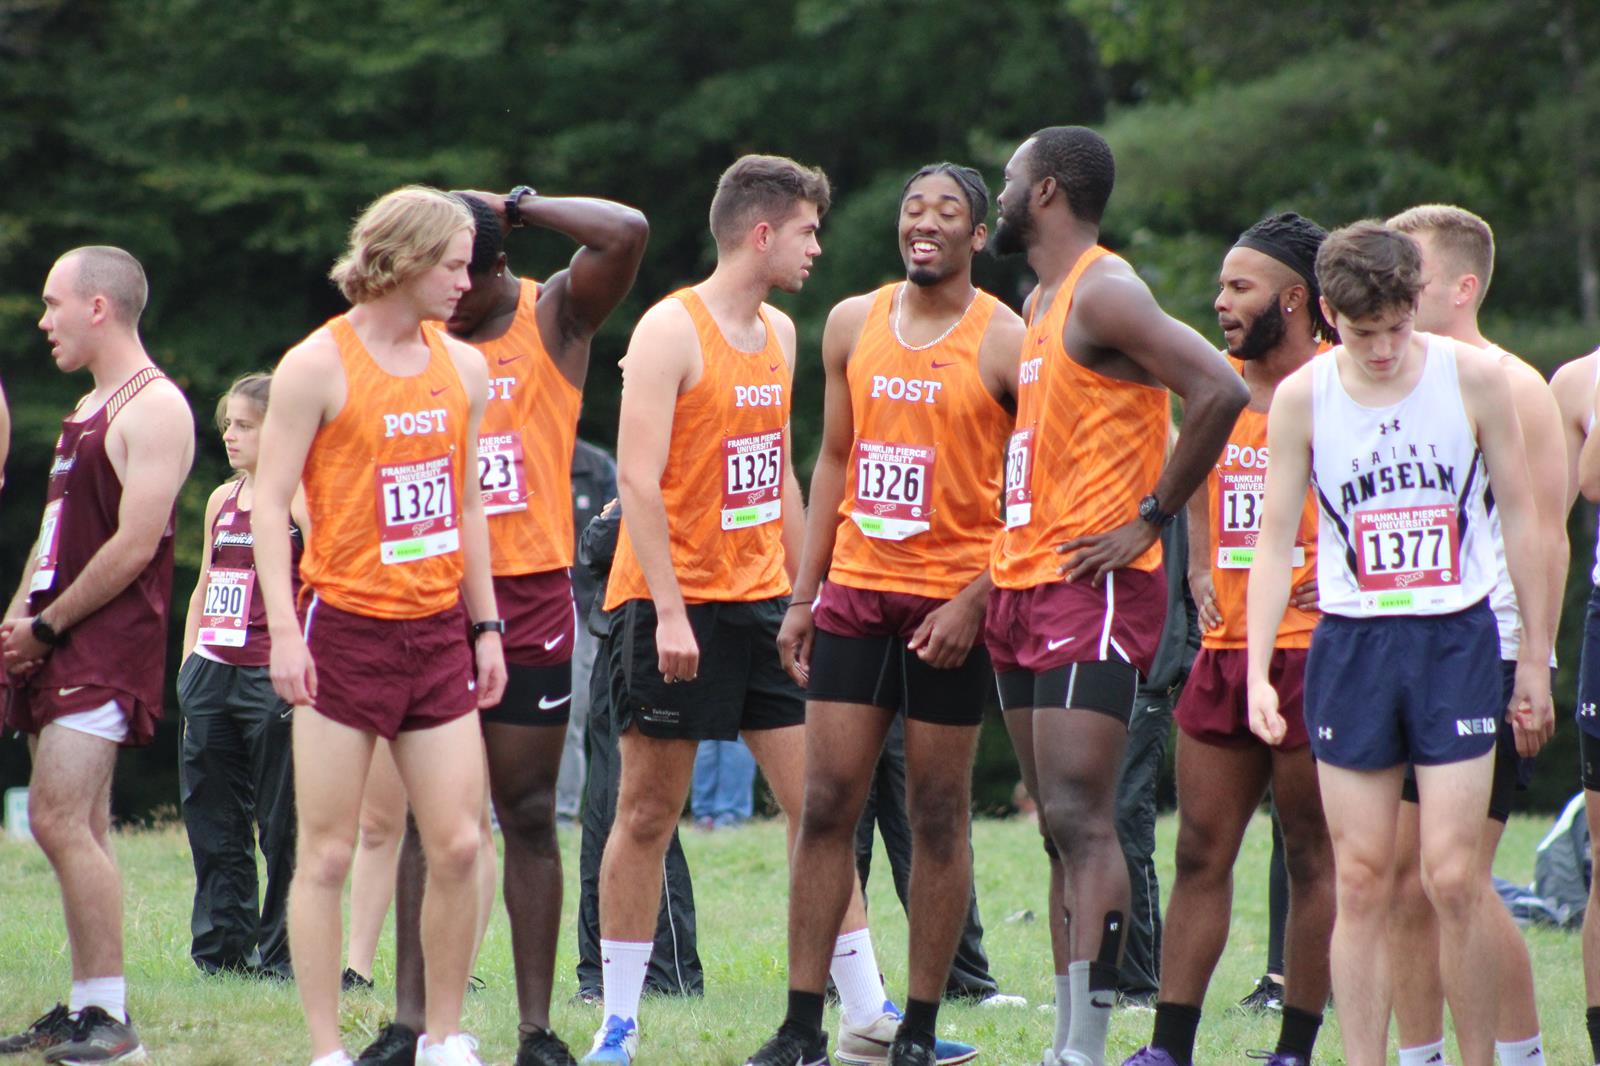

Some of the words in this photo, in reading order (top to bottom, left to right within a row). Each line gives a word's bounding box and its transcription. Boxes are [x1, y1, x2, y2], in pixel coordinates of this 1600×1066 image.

[1019, 357, 1043, 385] POST
[487, 377, 516, 400] ST
[734, 384, 782, 408] POST
[871, 375, 942, 404] POST
[383, 409, 448, 437] POST
[479, 435, 513, 447] PIERCE
[728, 435, 760, 449] FRANKLIN
[760, 432, 782, 443] PIERCE
[737, 441, 773, 454] UNIVERSITY
[860, 443, 895, 455] FRANKLIN
[895, 447, 928, 458] PIERCE
[382, 462, 425, 477] FRANKLIN
[425, 457, 449, 471] PIERCE
[868, 452, 914, 464] UNIVERSITY
[1225, 444, 1269, 469] POS
[1351, 443, 1437, 473] SAINT
[395, 467, 441, 483] UNIVERSITY
[478, 454, 512, 492] 23
[731, 449, 778, 492] 1325
[1008, 450, 1024, 488] 28
[1224, 474, 1263, 484] FRANKLIN
[861, 461, 920, 502] 1326
[1234, 482, 1265, 491] UNIVER
[389, 476, 446, 522] 1327
[1227, 492, 1264, 529] 13
[1361, 511, 1410, 524] FRANKLIN
[1411, 508, 1448, 519] PIERCE
[1375, 518, 1435, 531] UNIVERSITY
[213, 530, 254, 548] Norwich
[1368, 528, 1444, 572] 1377
[205, 585, 242, 615] 1290
[1456, 717, 1497, 736] NE10
